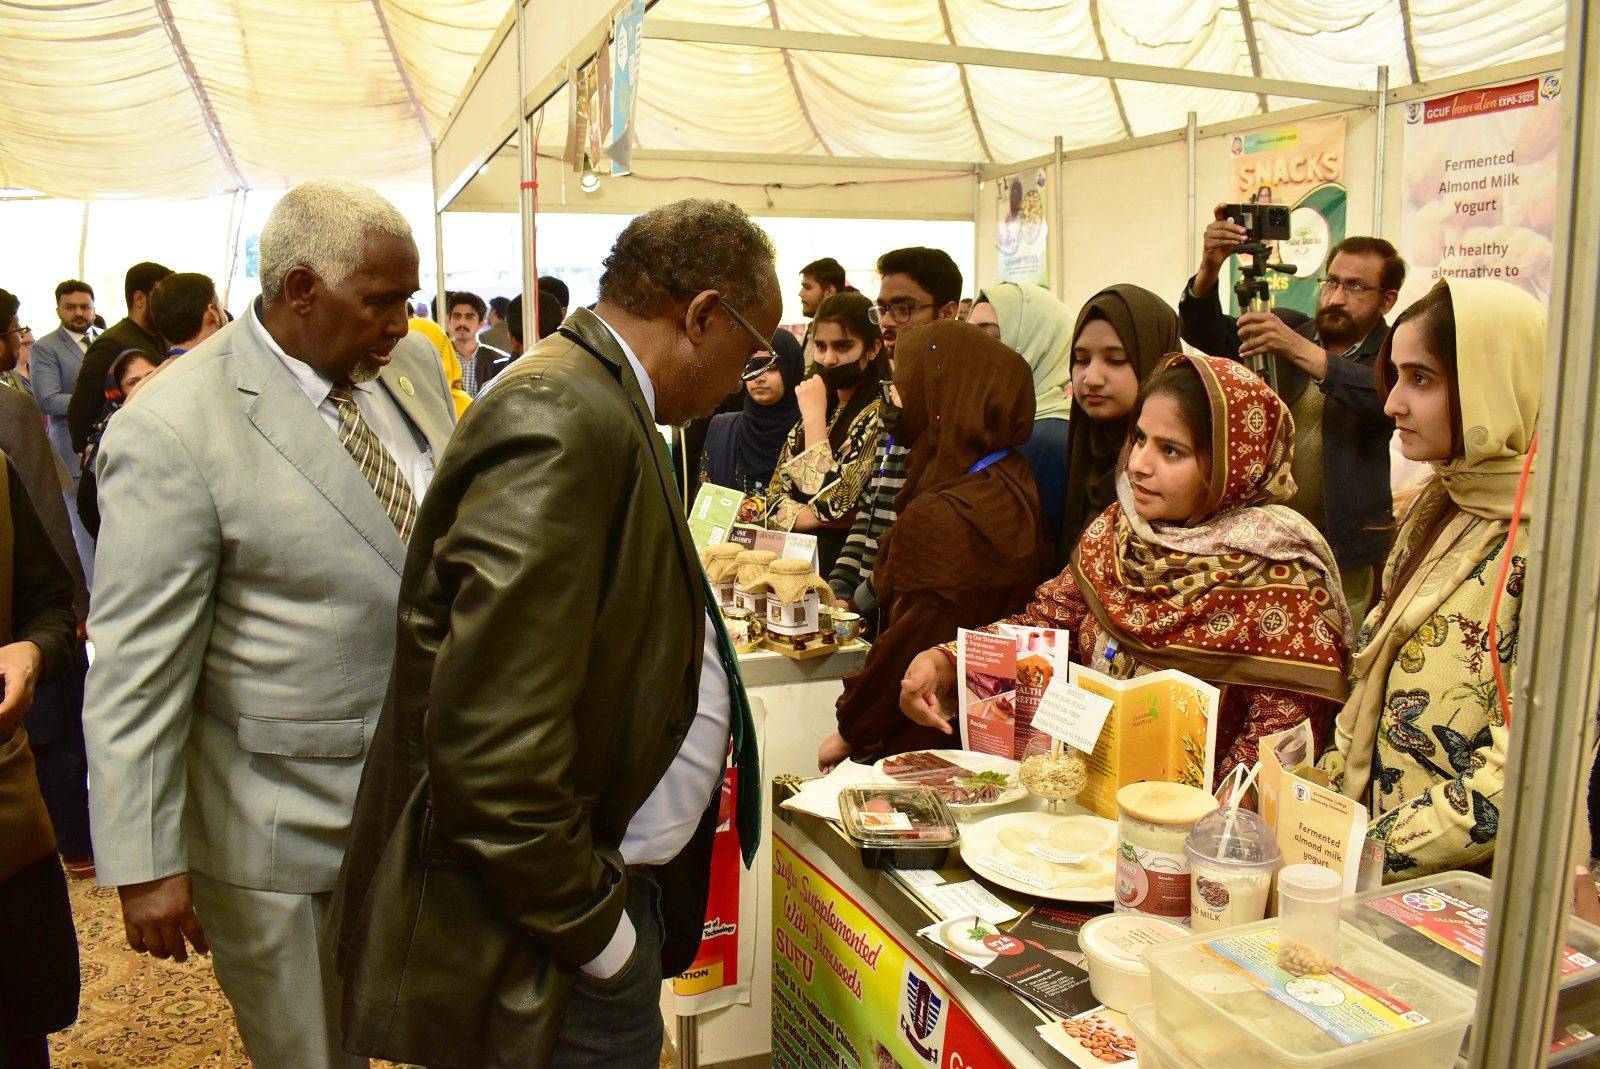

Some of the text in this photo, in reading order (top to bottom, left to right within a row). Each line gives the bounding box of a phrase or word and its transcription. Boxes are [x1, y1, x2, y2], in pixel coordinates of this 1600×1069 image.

[1426, 91, 1535, 119] GCUF Innovation EXPO-2025
[1445, 150, 1515, 171] Fermented
[1239, 151, 1341, 193] SNACKS
[1438, 173, 1520, 194] Almond Milk
[1454, 199, 1497, 216] Yogurt
[1443, 242, 1509, 260] (A healthy
[1431, 264, 1519, 280] alternative to
[970, 719, 988, 730] Recipe
[1298, 822, 1341, 848] Fermented
[1294, 834, 1322, 852] almond
[1324, 848, 1342, 862] milk
[1303, 850, 1329, 868] yogurt
[784, 894, 810, 939] With
[800, 875, 883, 972] Supplemented
[1200, 909, 1221, 921] MILK
[704, 925, 735, 937] Technology
[775, 926, 815, 983] SUFU
[676, 969, 709, 980] ATION
